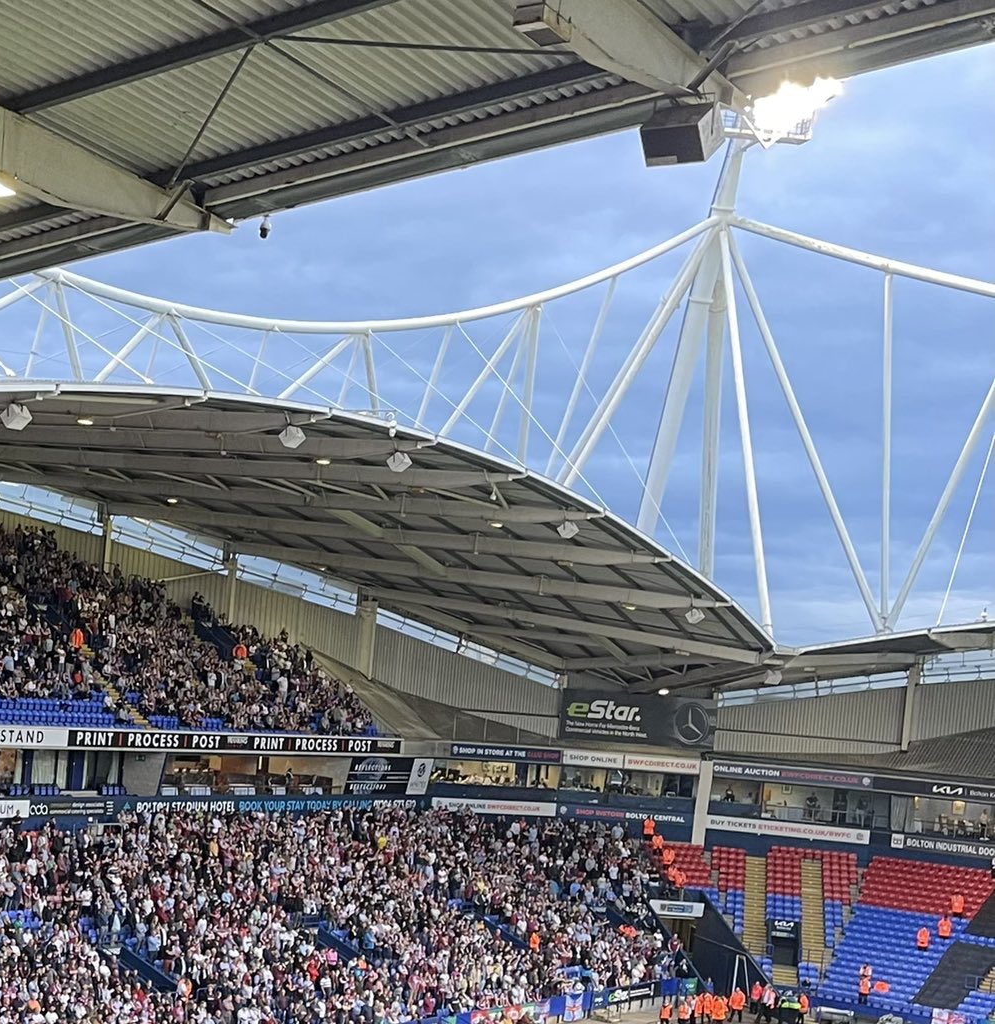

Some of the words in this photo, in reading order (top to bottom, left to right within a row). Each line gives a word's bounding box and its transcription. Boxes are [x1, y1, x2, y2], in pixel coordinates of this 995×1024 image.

[0, 727, 44, 744] STAND
[76, 731, 113, 747] PRINT
[127, 733, 179, 748] PROCESS
[192, 734, 220, 749] POST
[253, 737, 284, 750] PRINT
[295, 738, 338, 751] PROCESS
[348, 740, 371, 752] POST
[591, 756, 617, 764] ONLINE
[713, 765, 743, 774] ONLINE
[744, 768, 780, 777] AUCTION
[210, 800, 236, 812] HOTEL
[238, 800, 262, 811] BOOK
[263, 800, 286, 811] YOUR
[286, 800, 305, 811] STAY
[654, 814, 685, 823] CENTRAL
[727, 820, 757, 829] TICKETS
[906, 838, 935, 849] BOLTON
[935, 841, 977, 854] INDUSTRIAL
